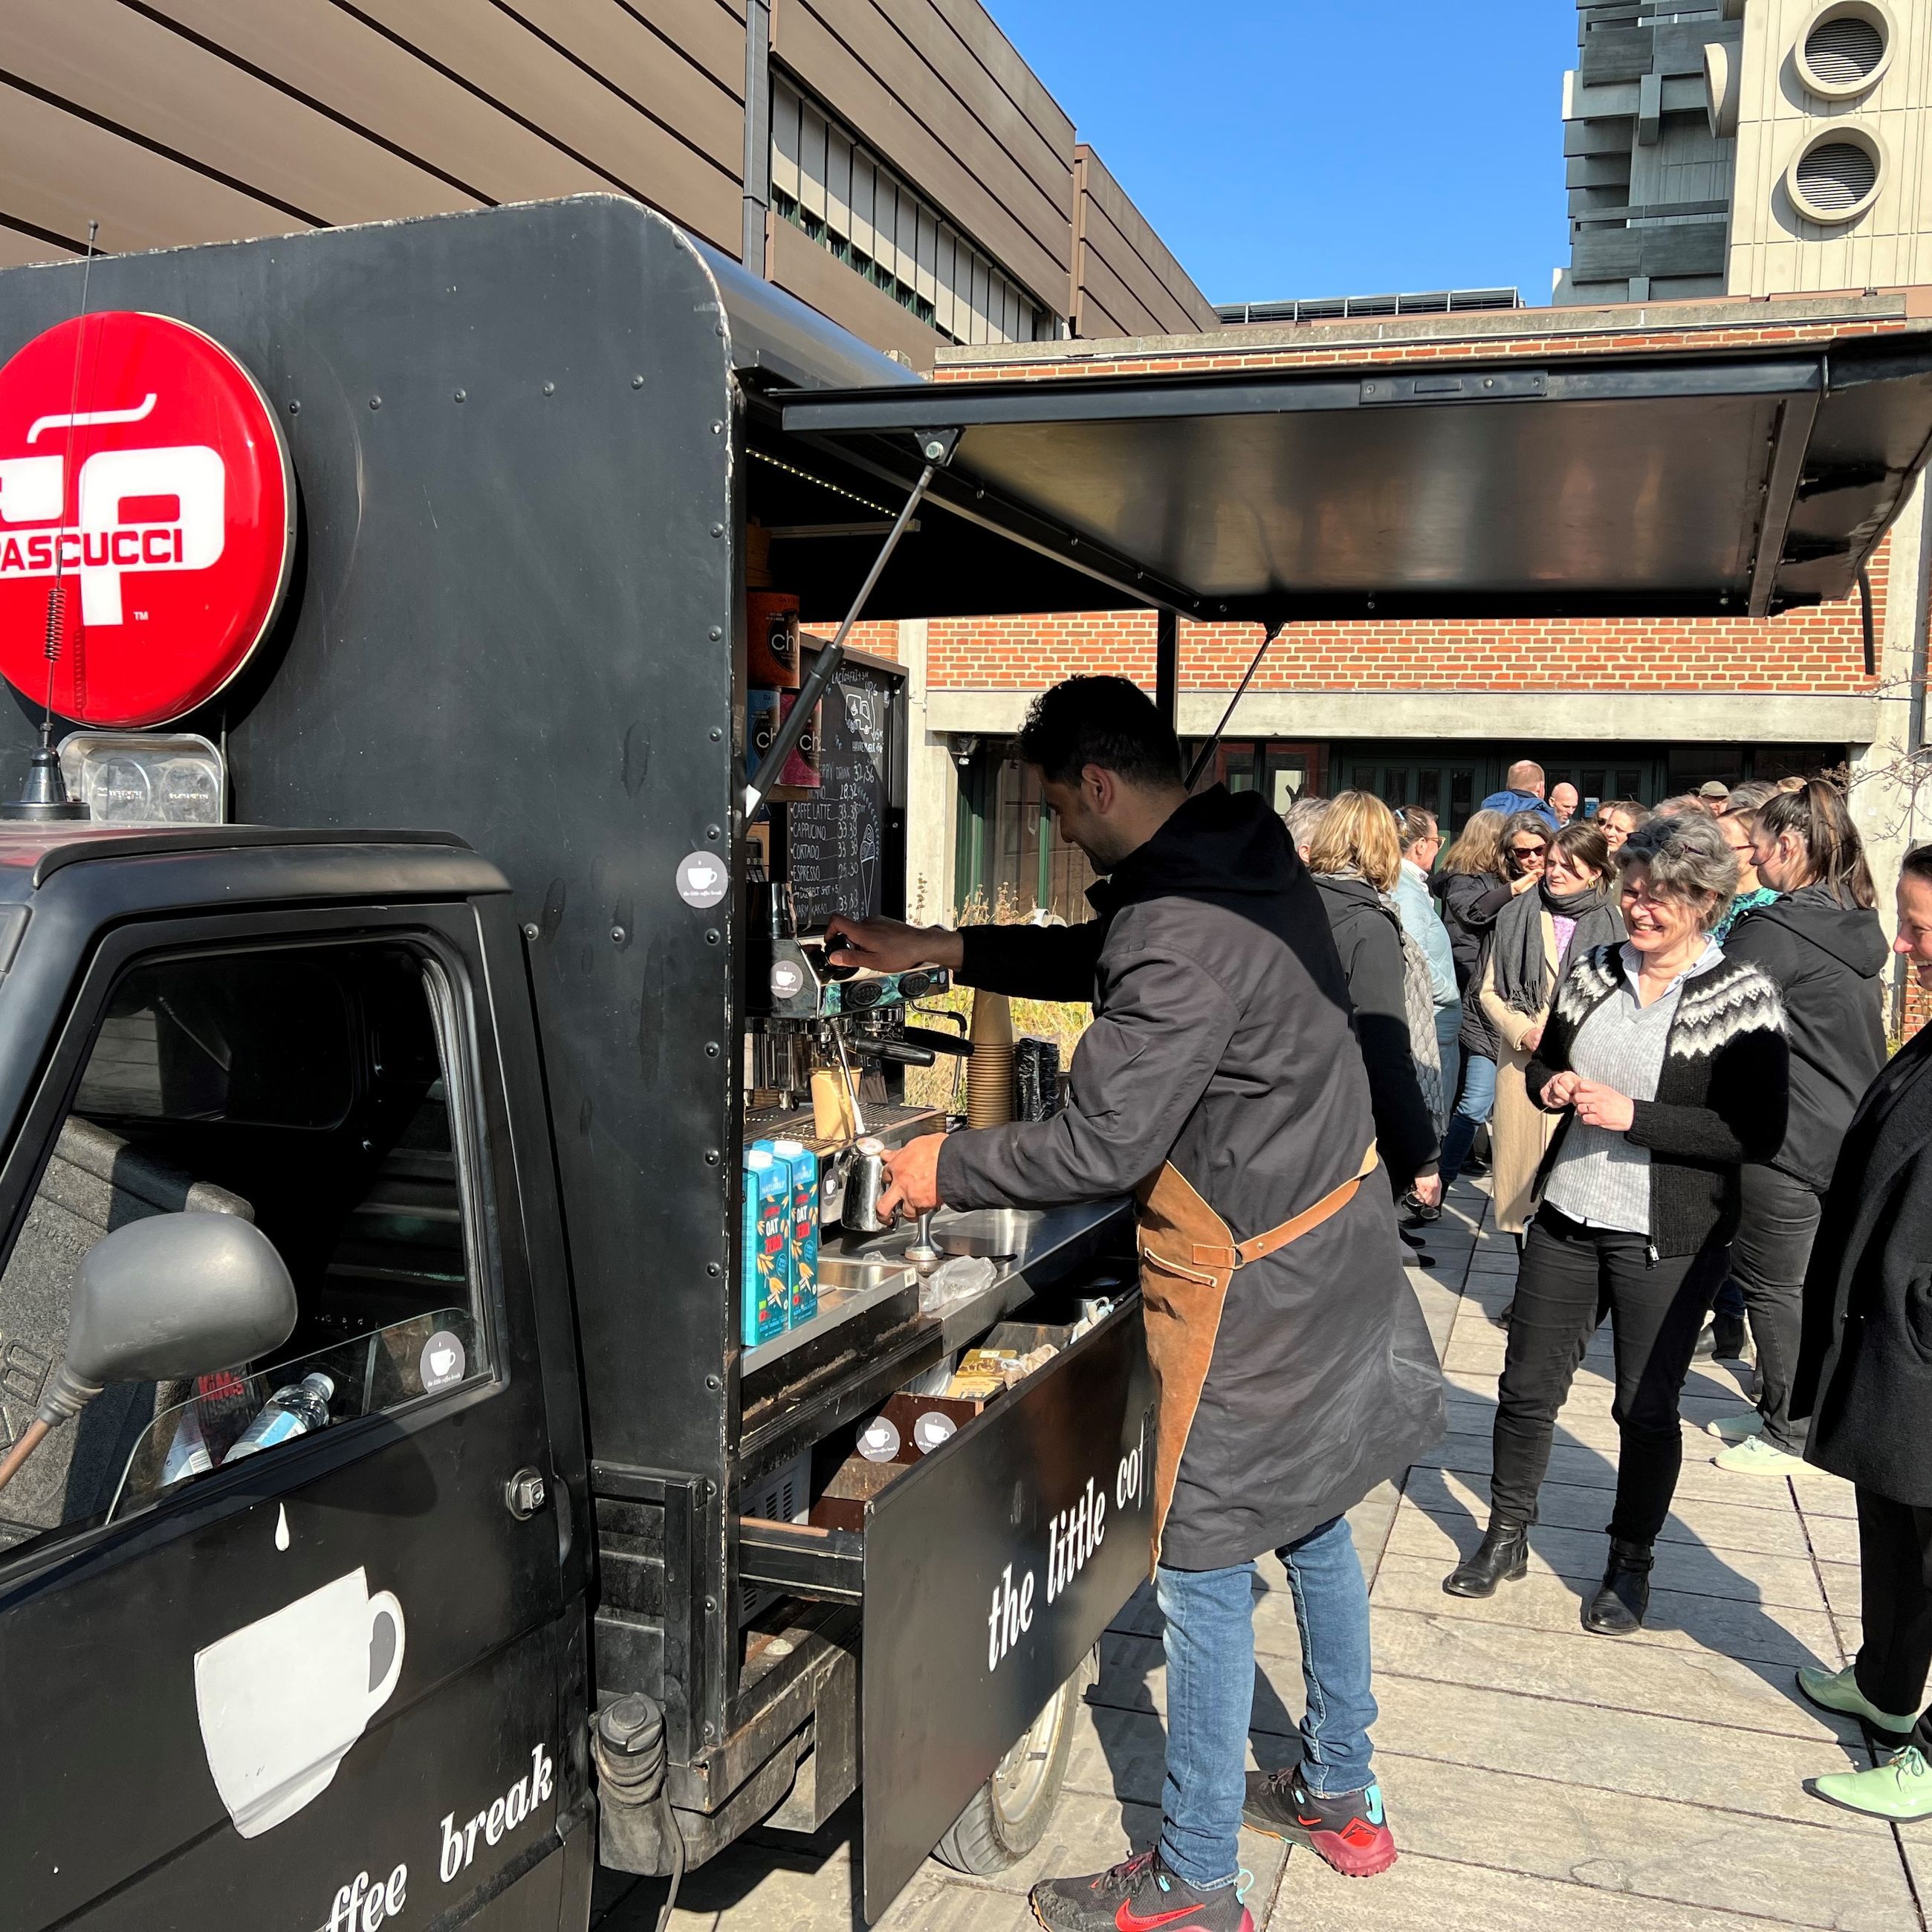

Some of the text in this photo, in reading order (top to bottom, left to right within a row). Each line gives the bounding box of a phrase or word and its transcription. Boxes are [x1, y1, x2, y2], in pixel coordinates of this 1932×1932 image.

[0, 528, 183, 571] ASCUCCI
[134, 611, 149, 620] TM
[792, 843, 820, 860] CORTADO
[792, 864, 820, 882] ESPRESSO
[797, 1205, 808, 1223] OAT
[766, 1217, 779, 1236] OAT
[988, 1561, 1034, 1673] the
[1046, 1475, 1106, 1606] little
[440, 1743, 554, 1883] break
